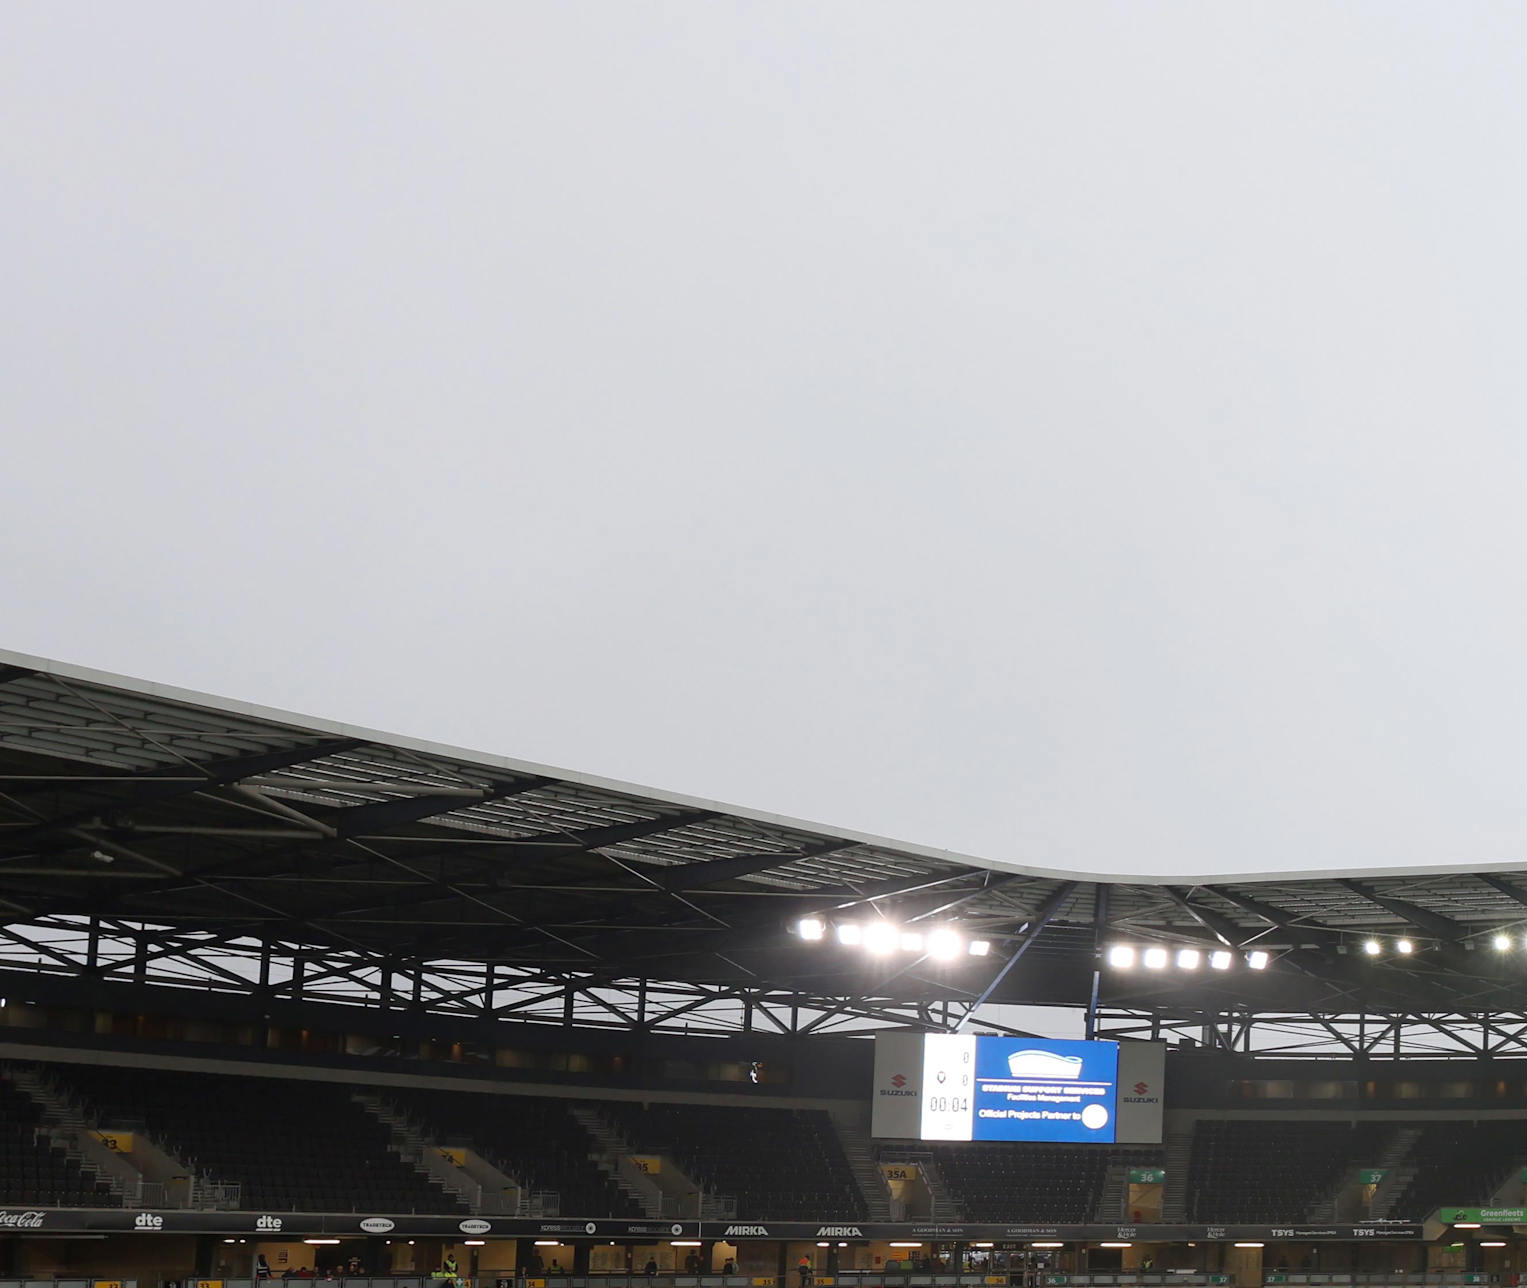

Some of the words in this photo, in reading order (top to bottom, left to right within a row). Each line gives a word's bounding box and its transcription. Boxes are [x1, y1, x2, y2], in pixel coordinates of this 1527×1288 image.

[978, 1109, 1007, 1119] Official
[1008, 1110, 1040, 1120] Projects
[1042, 1110, 1070, 1119] Partner
[1071, 1111, 1081, 1120] to
[888, 1170, 907, 1179] 35A
[1140, 1173, 1153, 1182] 36
[1370, 1174, 1381, 1183] 37
[135, 1214, 163, 1227] dte
[257, 1216, 282, 1228] dte
[724, 1226, 768, 1236] MIRKA
[817, 1227, 862, 1237] MIRKA
[1272, 1229, 1294, 1237] TSYS
[1353, 1229, 1374, 1237] TSYS
